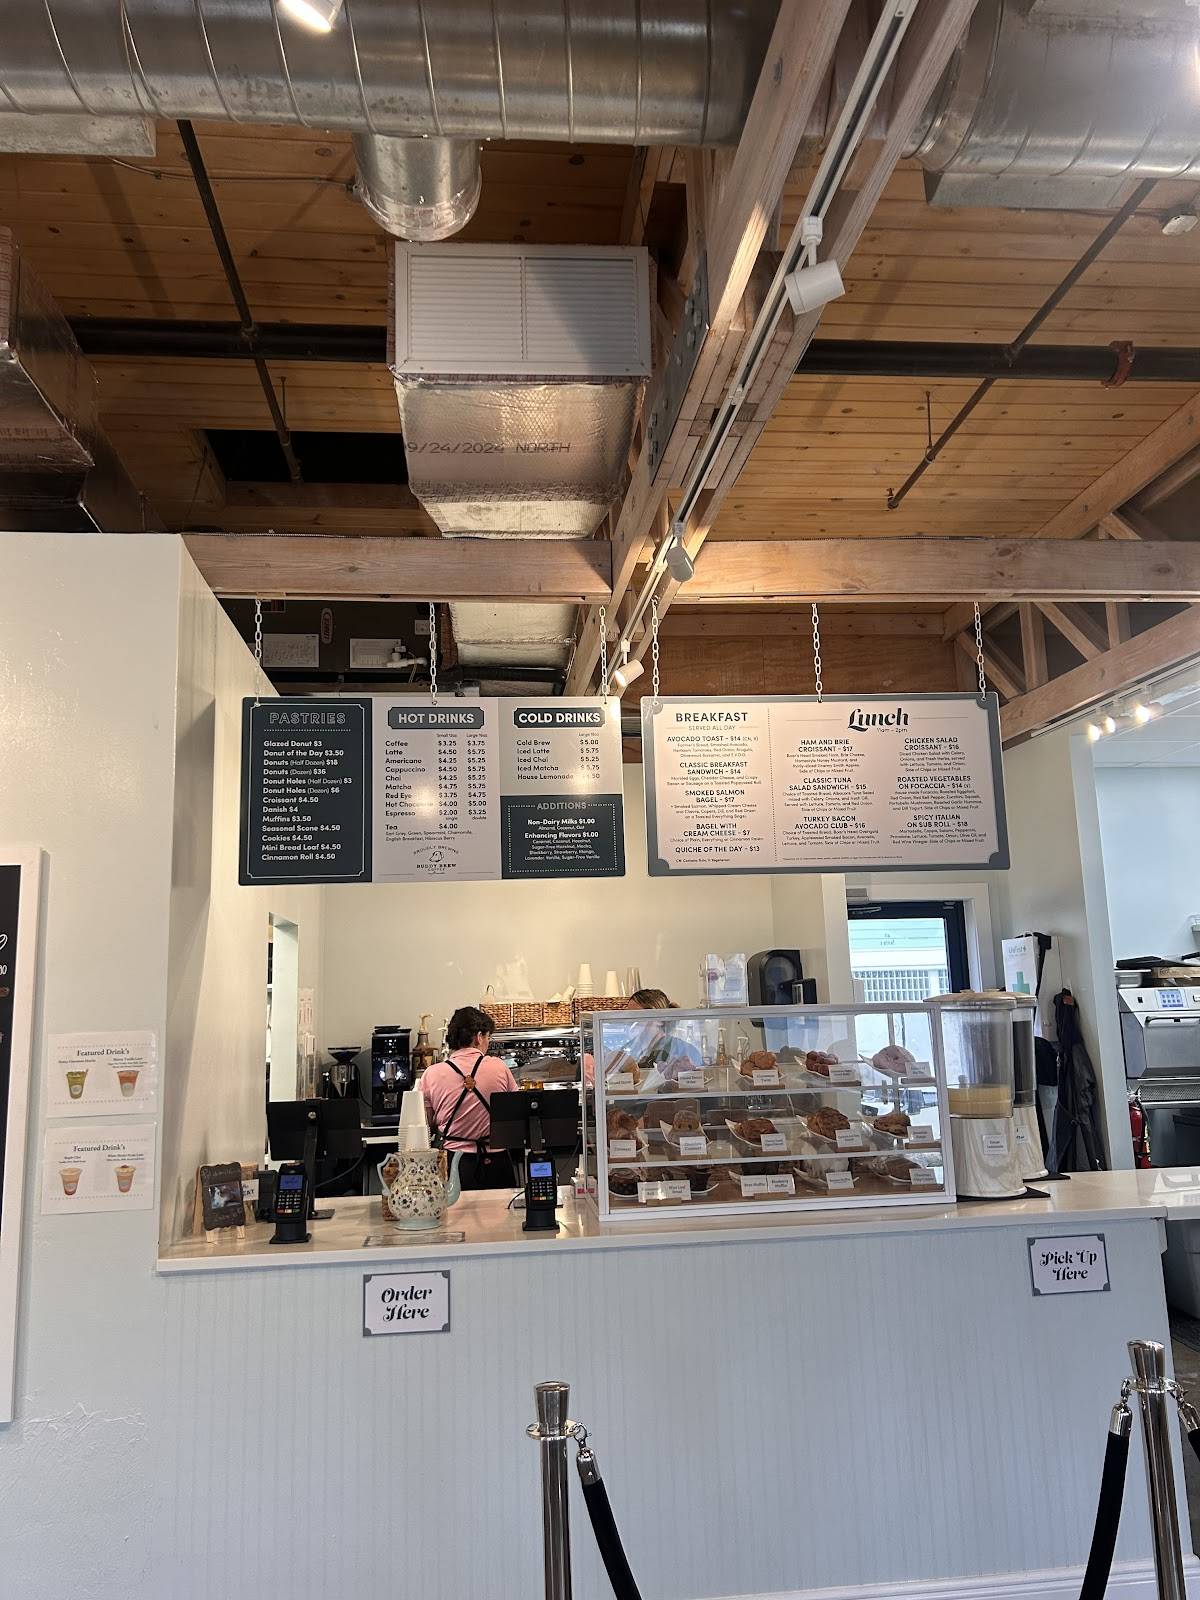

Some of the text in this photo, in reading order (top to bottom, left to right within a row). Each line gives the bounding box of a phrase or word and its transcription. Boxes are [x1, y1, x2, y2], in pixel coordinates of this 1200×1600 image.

[516, 443, 570, 453] NORTH
[269, 712, 346, 724] PASTRIES
[398, 713, 474, 724] HOT DRINKS
[519, 712, 600, 723] COLD DRINKS
[676, 712, 748, 721] BREAKFAST
[848, 708, 908, 732] Lunch
[537, 802, 587, 810] ADDITIONS
[1040, 1250, 1097, 1266] Pick Up
[1052, 1267, 1088, 1281] Here
[381, 1285, 432, 1303] Order
[383, 1304, 429, 1322] Here
